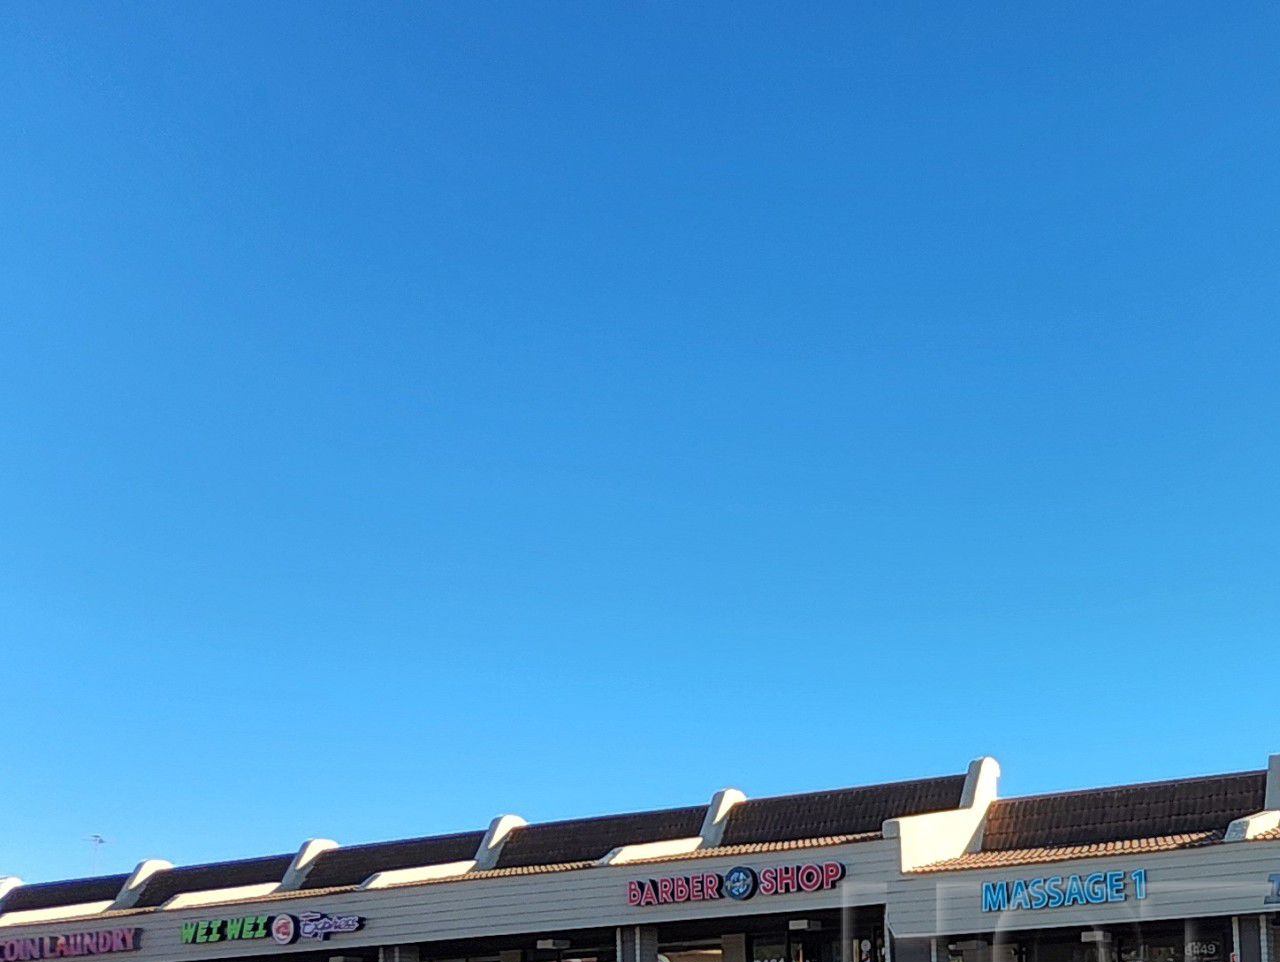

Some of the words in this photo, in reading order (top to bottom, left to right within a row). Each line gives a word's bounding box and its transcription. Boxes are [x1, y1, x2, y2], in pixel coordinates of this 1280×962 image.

[627, 873, 720, 907] BARBER
[760, 862, 842, 895] SHOP
[982, 871, 1126, 912] MASSAGE
[1131, 869, 1147, 899] 1
[43, 928, 137, 958] LAUNDRY
[181, 919, 223, 944] WEI
[227, 914, 268, 940] WEI
[300, 911, 360, 941] Express
